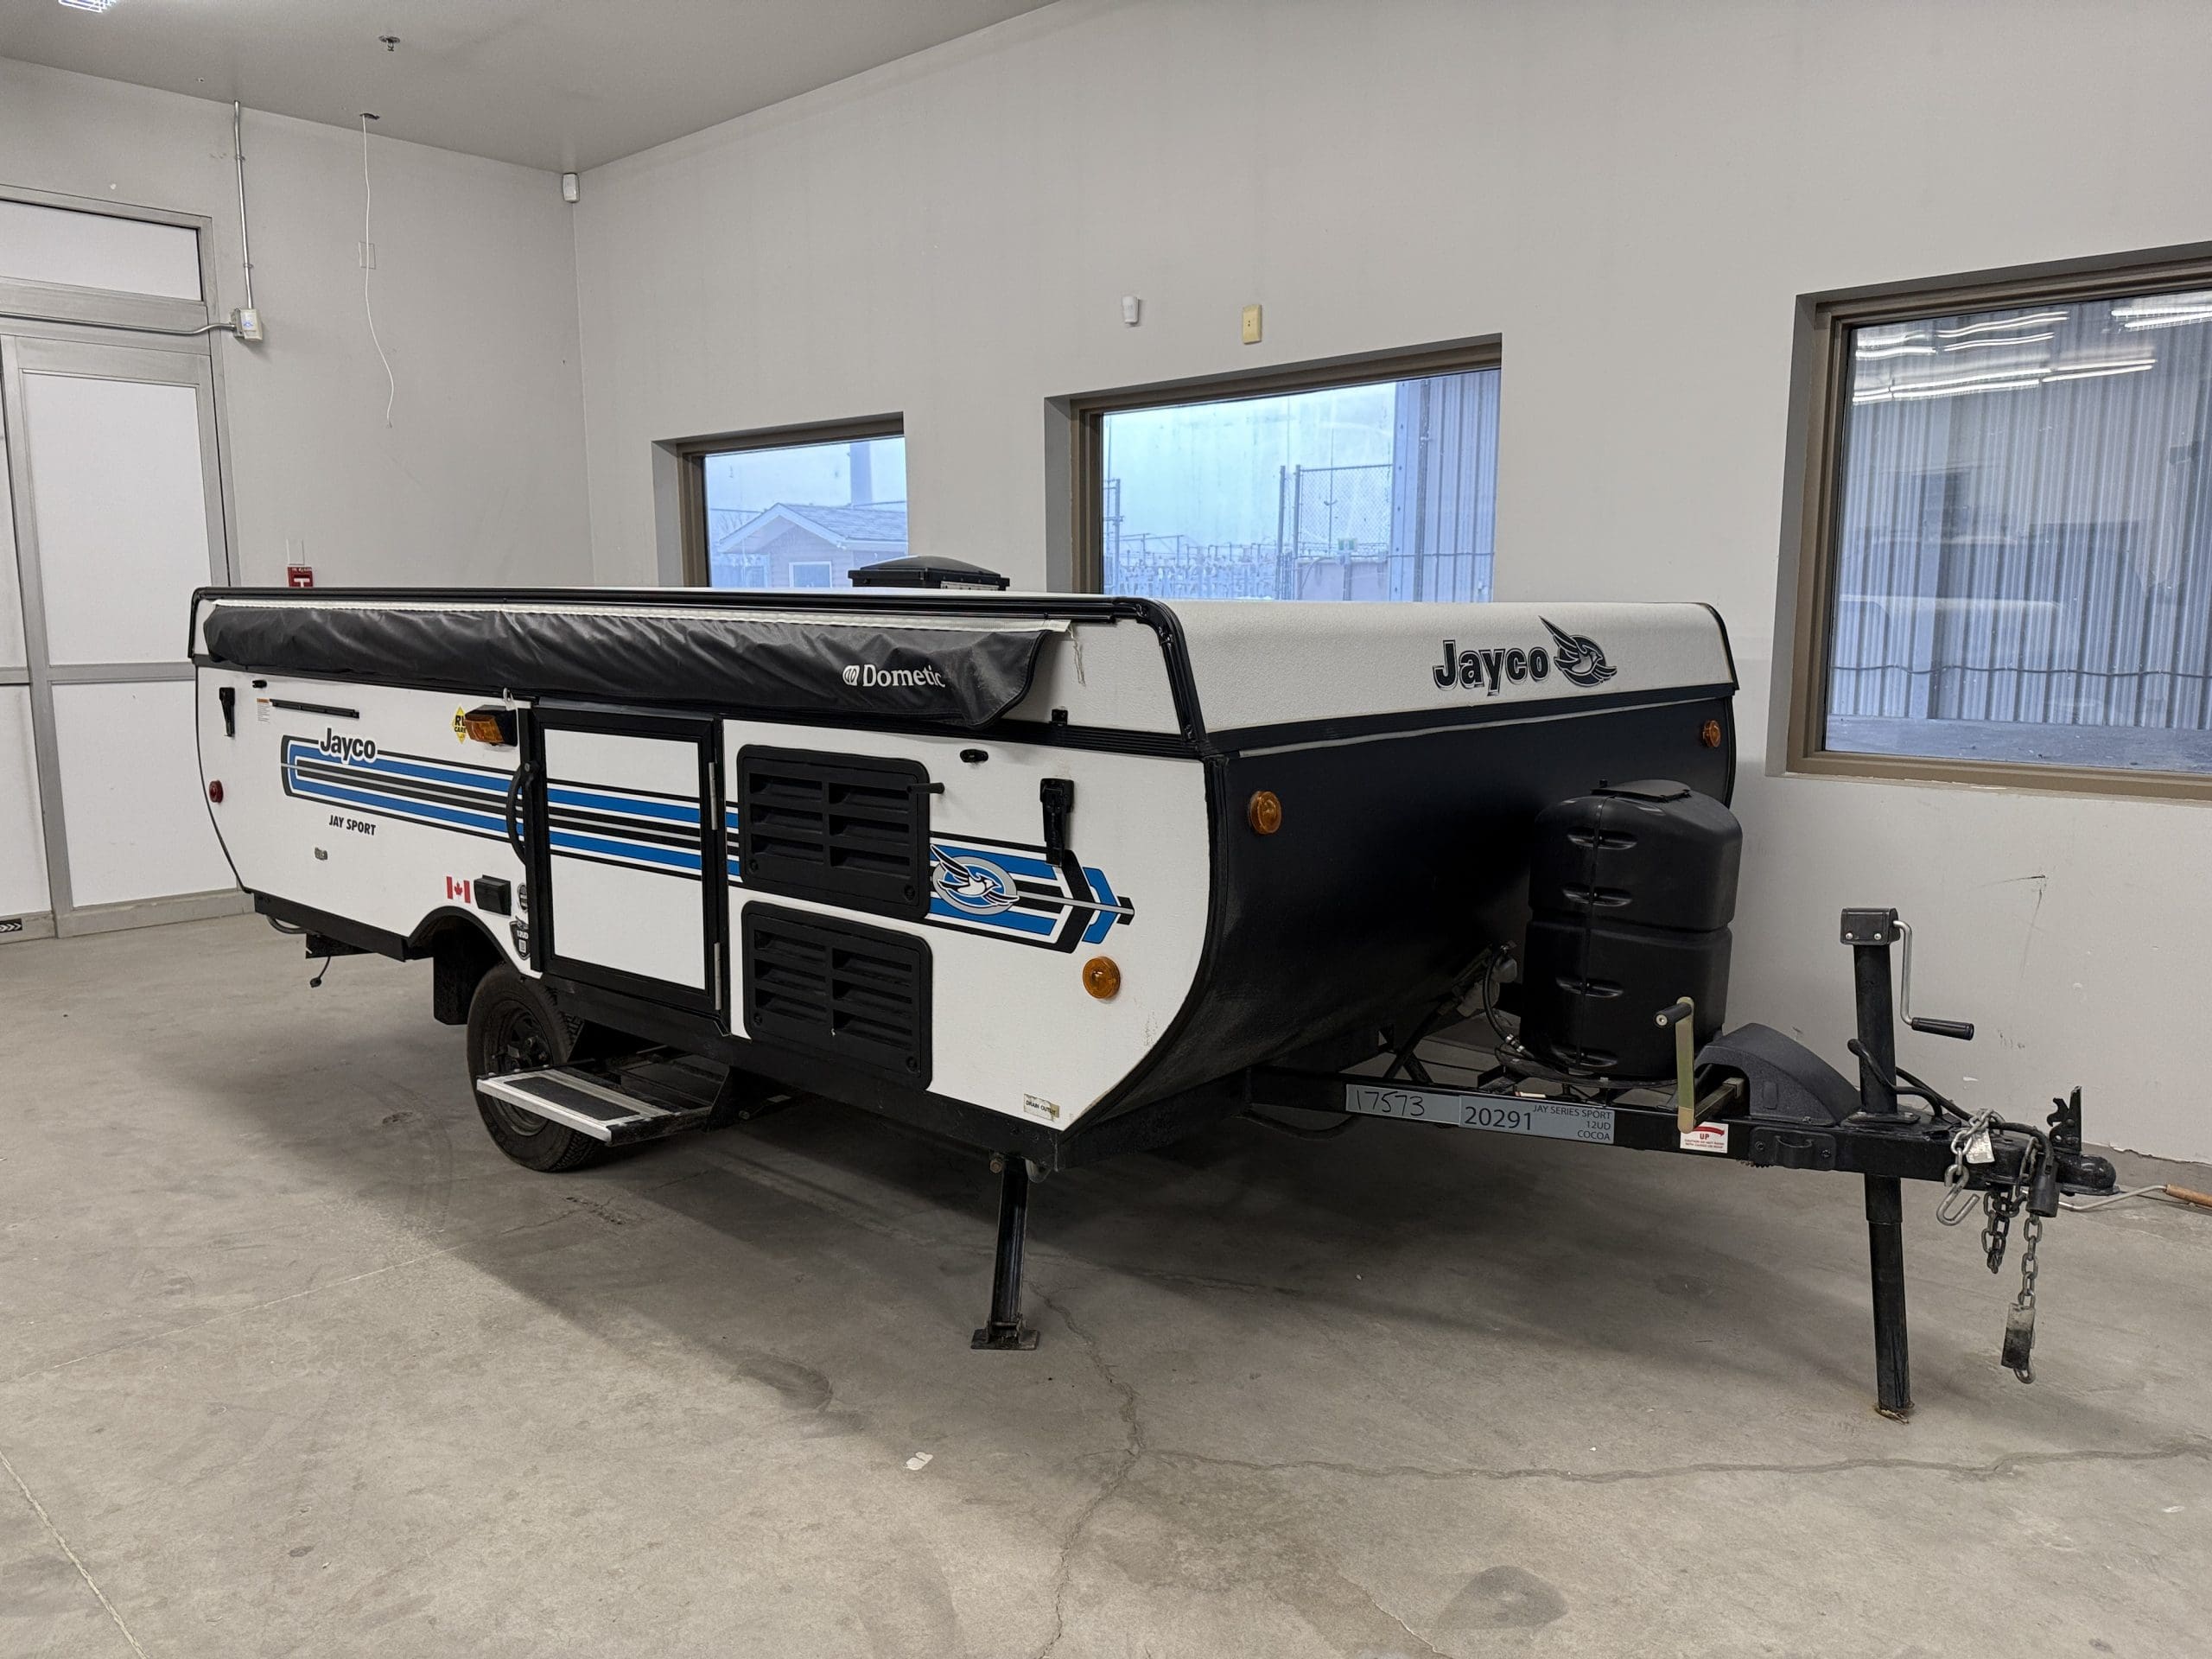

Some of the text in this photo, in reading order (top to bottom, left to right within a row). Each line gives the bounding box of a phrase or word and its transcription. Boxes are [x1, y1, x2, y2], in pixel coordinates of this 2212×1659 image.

[862, 664, 945, 688] Dometic
[1433, 639, 1551, 696] Jayco
[320, 728, 376, 761] Jayco
[329, 815, 377, 836] JAY SPORT
[1026, 1100, 1039, 1109] DRAIN
[1357, 1090, 1425, 1116] 17573
[1533, 1104, 1612, 1120] JAY SERIES SPORT
[1465, 1106, 1531, 1131] 20291
[1586, 1121, 1611, 1130] 12UD
[1577, 1130, 1611, 1141] COCOA
